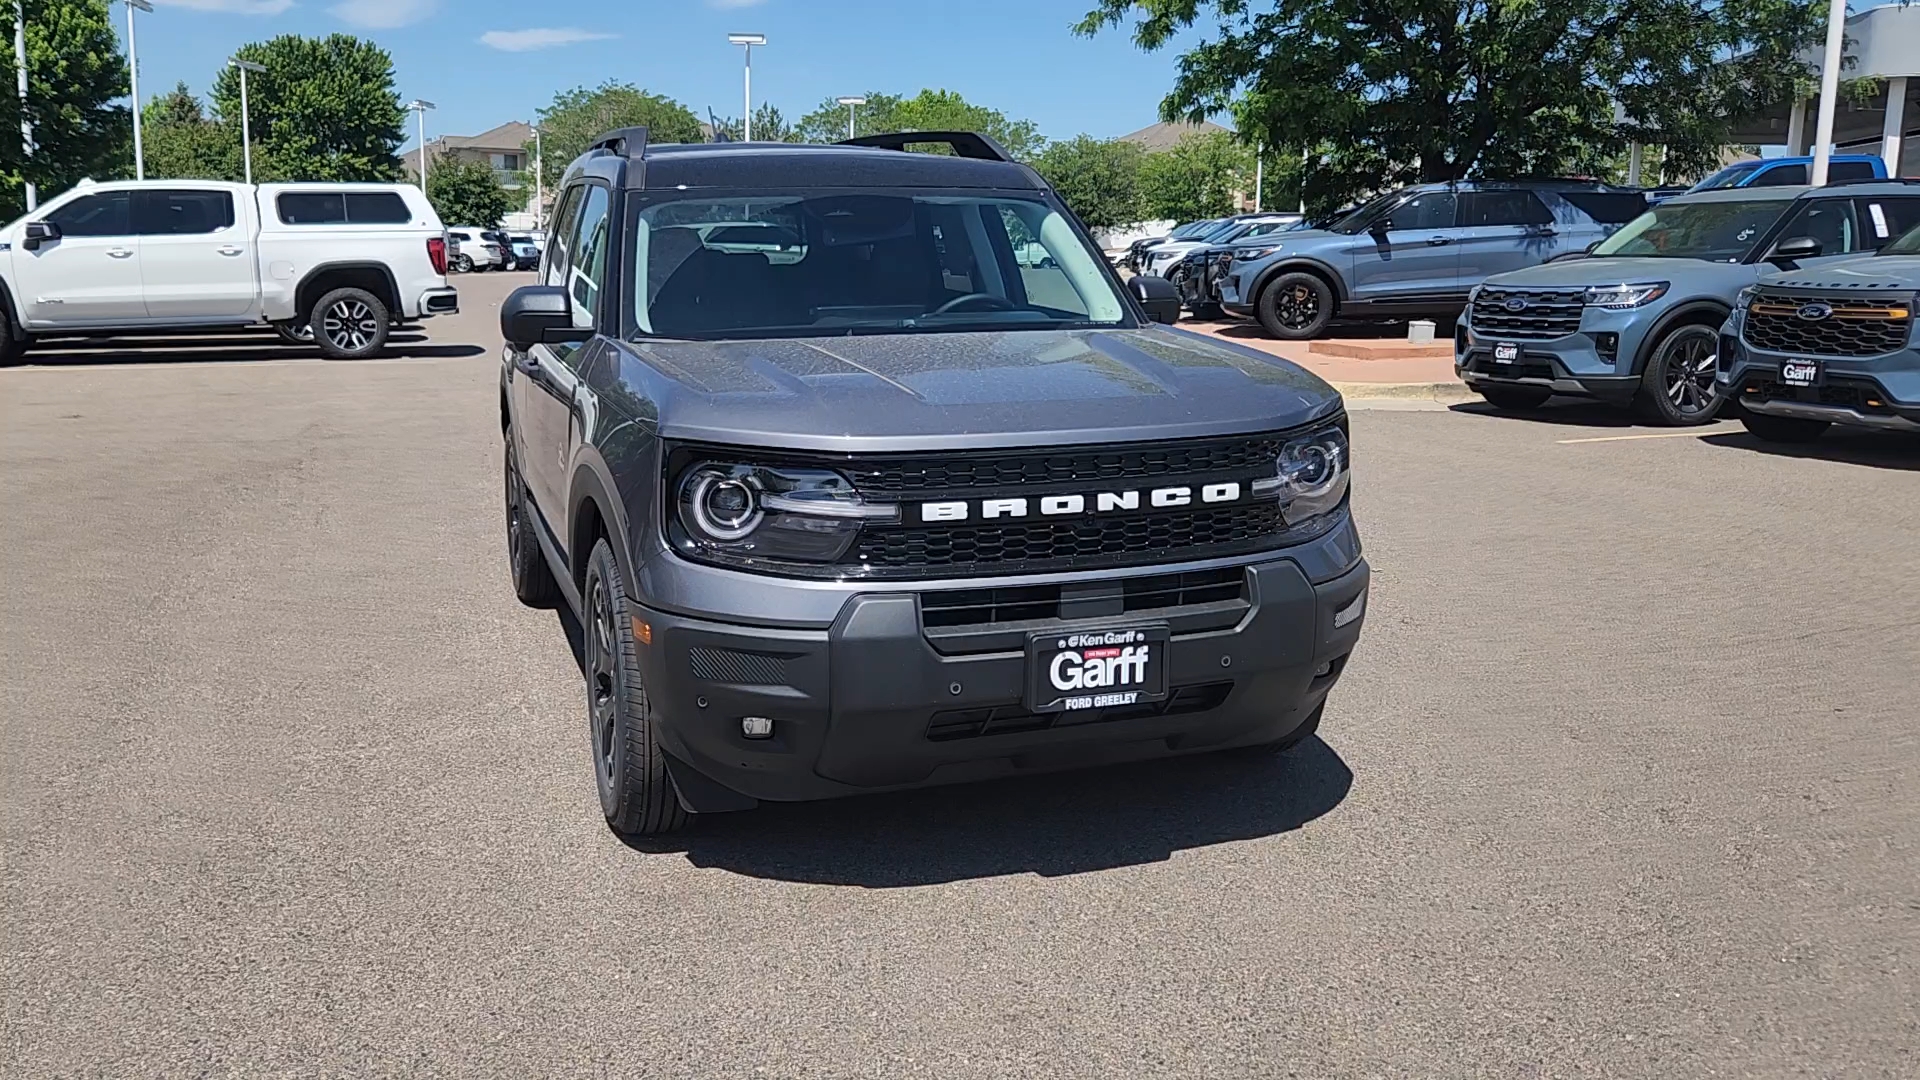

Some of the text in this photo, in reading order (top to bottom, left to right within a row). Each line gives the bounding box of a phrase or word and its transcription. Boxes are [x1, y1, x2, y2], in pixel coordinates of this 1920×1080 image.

[1802, 308, 1821, 317] Ford
[1495, 346, 1517, 359] Garff
[1783, 364, 1816, 380] Garff
[921, 482, 1240, 522] BRONCO
[1079, 634, 1103, 647] Ken
[1104, 631, 1135, 644] Garff
[1050, 645, 1149, 691] Garff
[1065, 692, 1137, 710] FORD GREELEY
